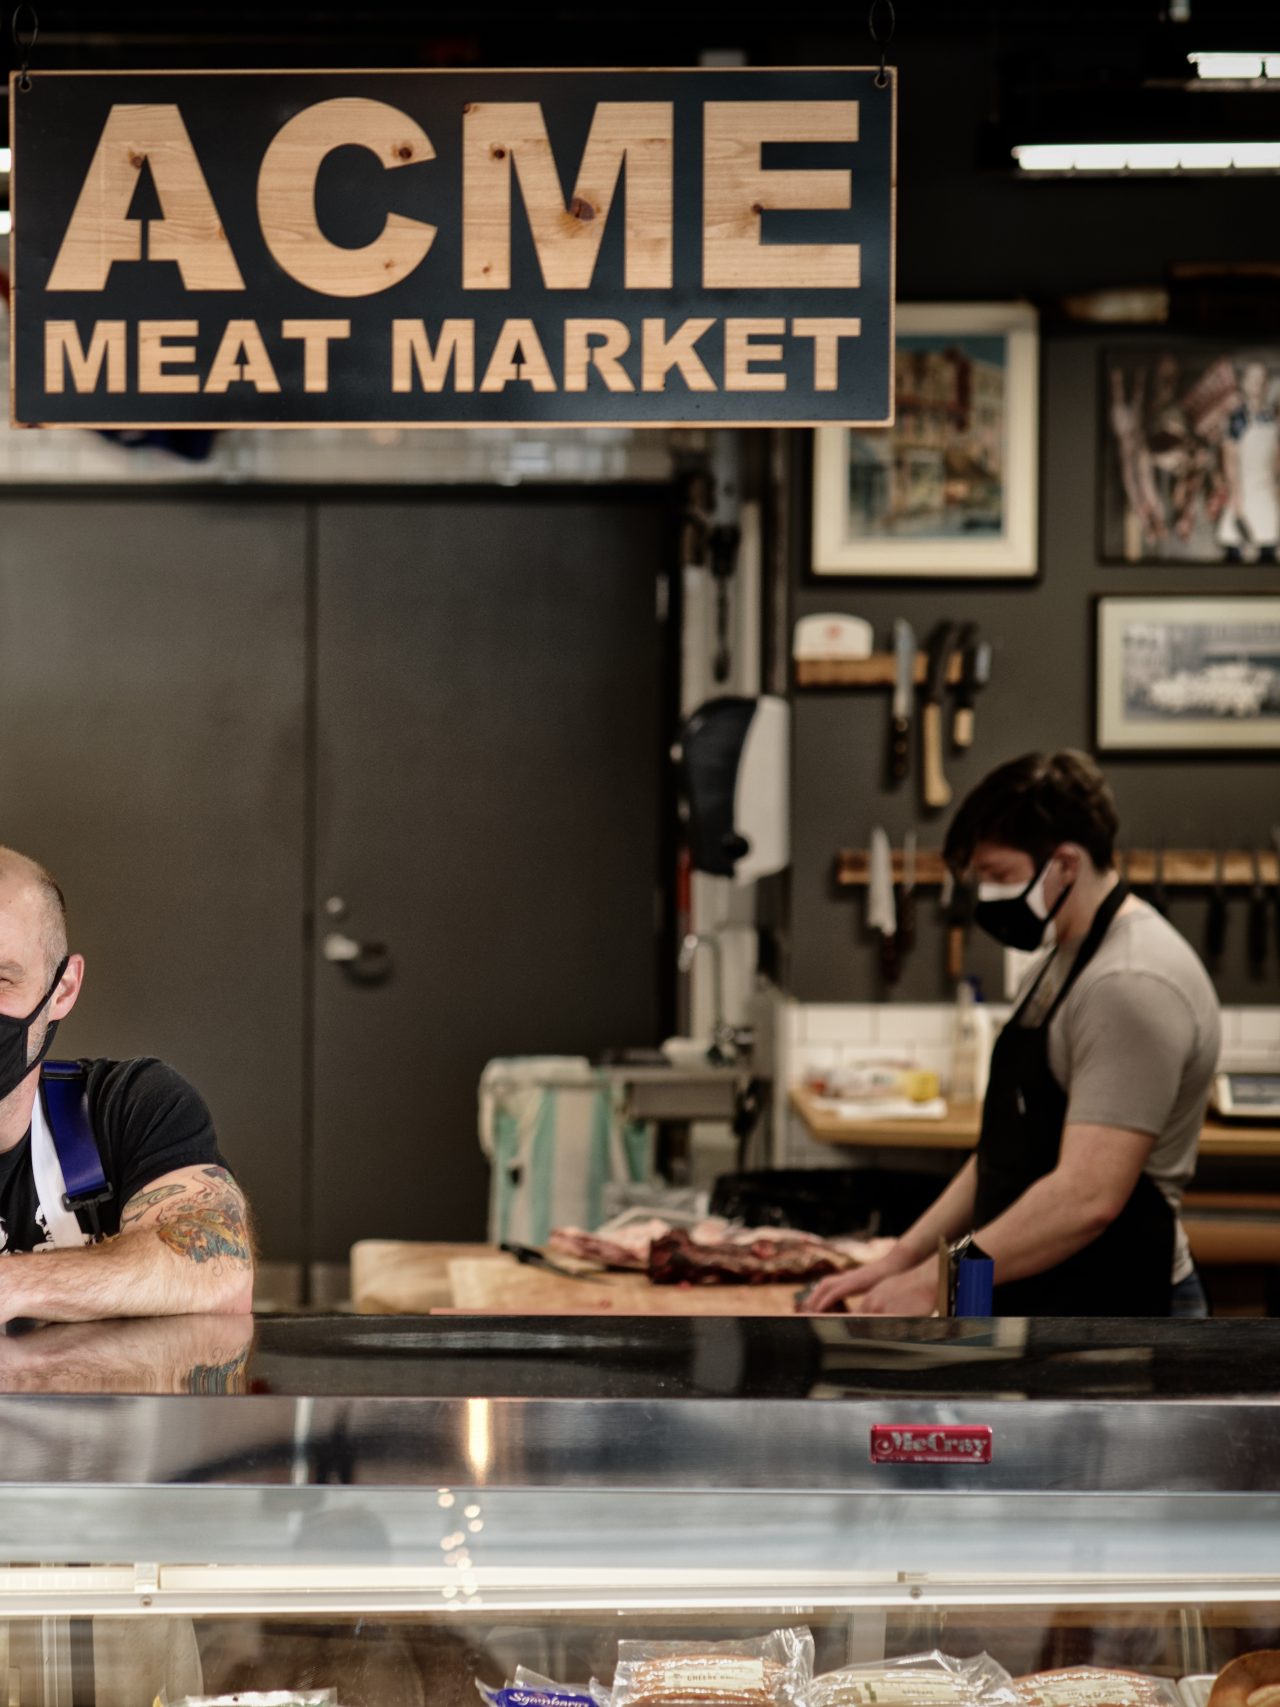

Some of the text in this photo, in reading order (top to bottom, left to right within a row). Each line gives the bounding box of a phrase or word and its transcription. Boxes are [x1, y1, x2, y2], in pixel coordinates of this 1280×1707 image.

[46, 98, 861, 298] ACME
[44, 317, 861, 393] MEAT MARKET
[875, 1431, 988, 1457] McCray
